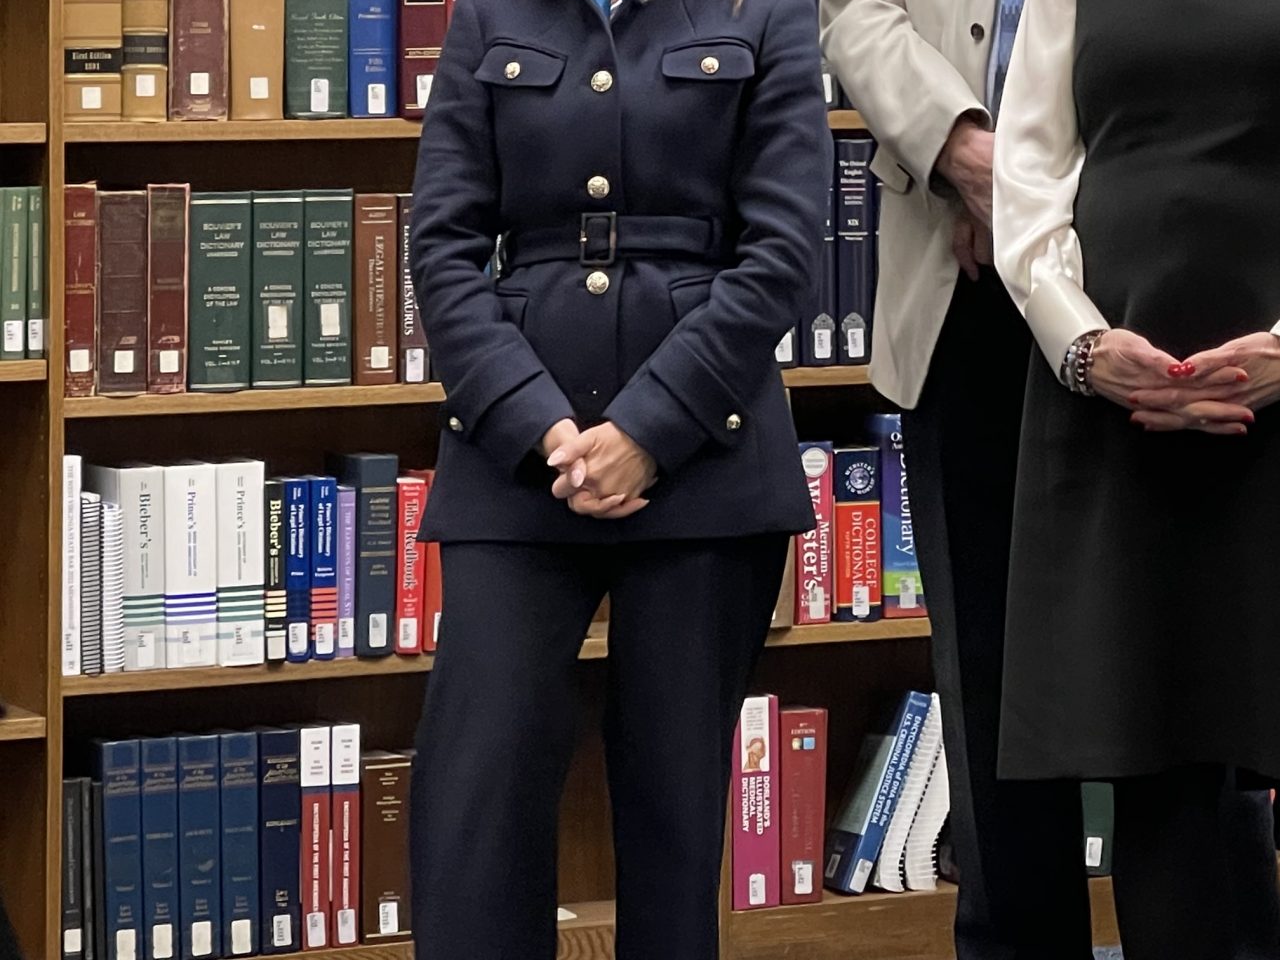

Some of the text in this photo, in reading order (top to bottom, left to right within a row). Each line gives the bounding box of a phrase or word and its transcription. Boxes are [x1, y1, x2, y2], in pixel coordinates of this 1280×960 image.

[200, 242, 245, 250] DICTIONARY
[270, 231, 288, 239] LAW
[321, 230, 338, 238] LAW
[375, 235, 385, 275] LEGAL
[139, 493, 153, 549] Bieber's
[187, 491, 198, 530] Prince's
[236, 490, 247, 530] Prince's
[289, 511, 297, 528] Legal
[316, 510, 325, 526] Legal
[317, 502, 325, 510] of
[269, 499, 282, 557] Bieber's
[296, 504, 305, 558] Prince's Dictionary
[323, 502, 333, 557] Prince's Dictionary
[402, 499, 420, 591] The Redbook
[864, 518, 877, 588] COLLEGE
[344, 601, 353, 616] STY
[889, 728, 908, 765] CRIMINAL
[899, 715, 922, 771] ENCYCLOPEDIA
[880, 765, 895, 794] JUSTICE
[889, 780, 900, 799] DNA
[756, 776, 764, 835] ILLUSTRATED
[870, 794, 886, 824] SYSTEM
